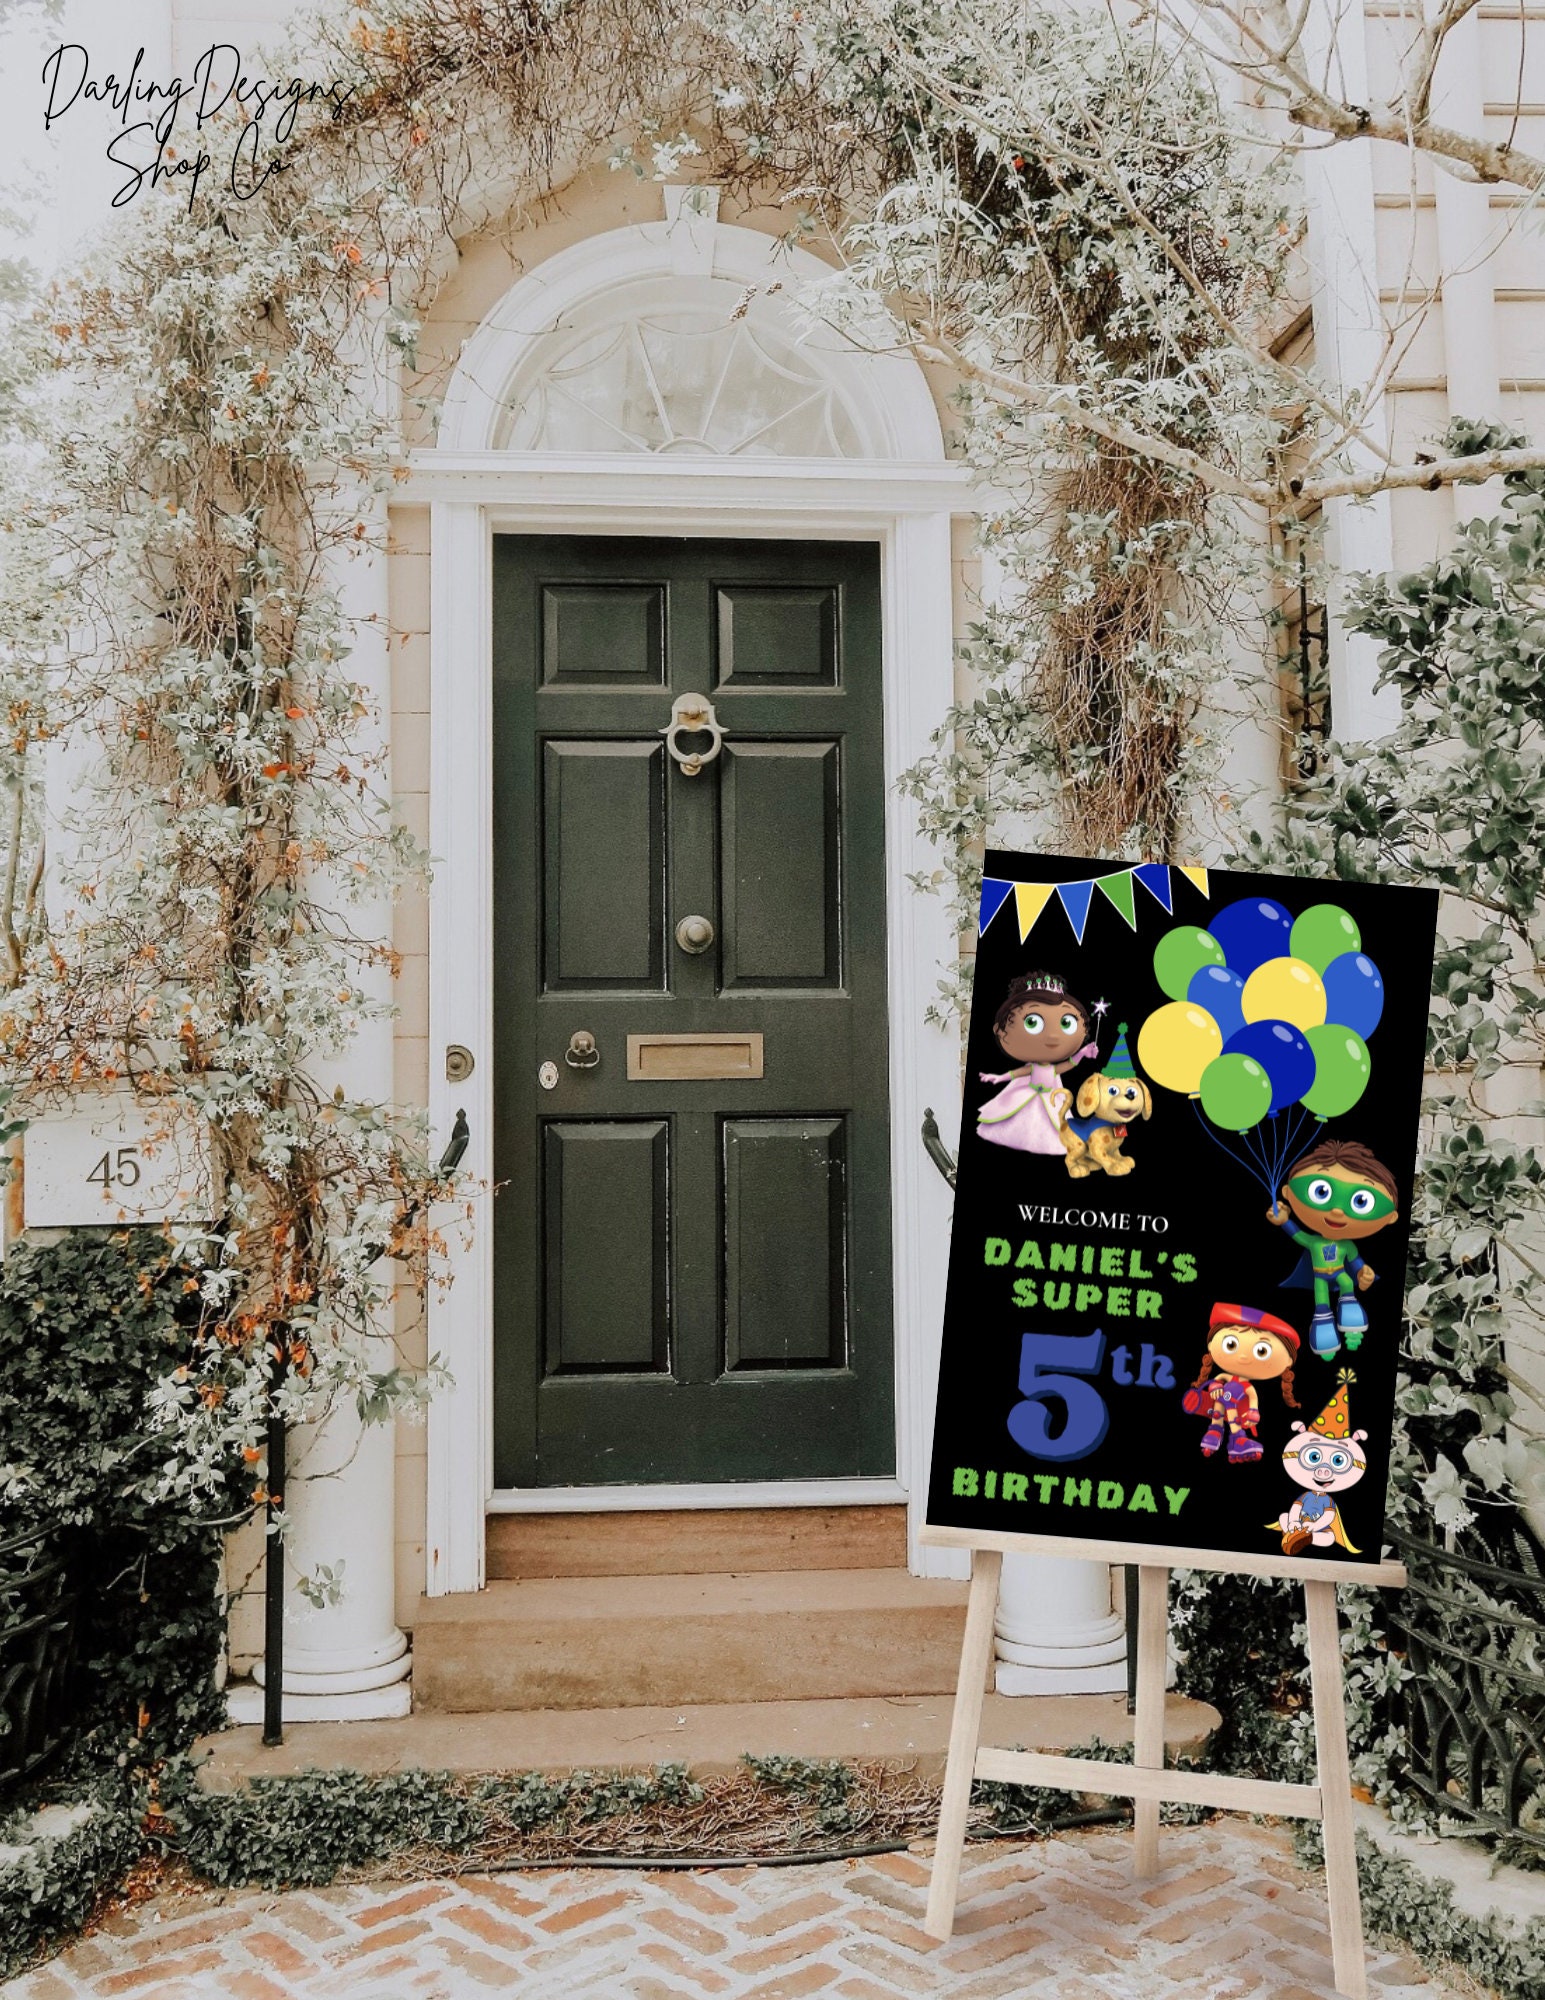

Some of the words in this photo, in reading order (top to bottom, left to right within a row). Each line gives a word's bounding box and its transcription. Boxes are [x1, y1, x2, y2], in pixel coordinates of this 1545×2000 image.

[86, 1147, 141, 1188] 45
[1018, 1204, 1131, 1231] WELCOME
[1136, 1214, 1169, 1233] TO
[984, 1237, 1198, 1283] DANIEL'S
[1011, 1278, 1163, 1319] SUPER
[1006, 1328, 1176, 1462] 5th
[952, 1467, 1191, 1516] BIRTHDAY
